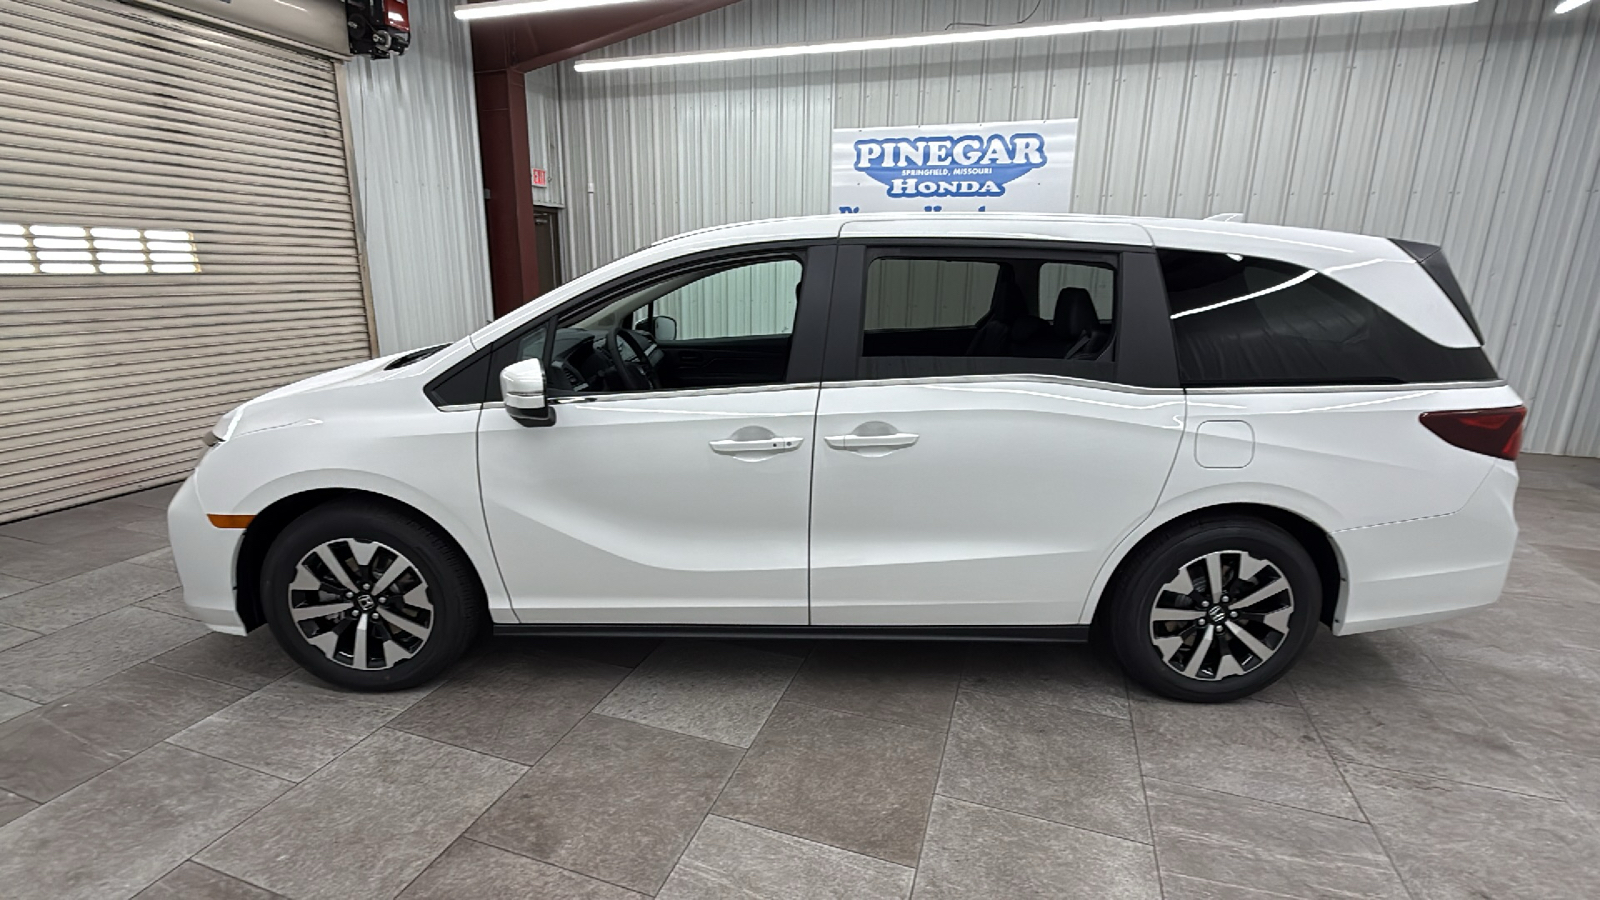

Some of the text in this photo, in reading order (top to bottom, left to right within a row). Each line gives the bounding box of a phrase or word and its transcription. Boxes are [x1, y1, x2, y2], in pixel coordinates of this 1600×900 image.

[857, 136, 1043, 169] PINEGAR
[901, 167, 993, 177] SPRINGFIELD, MISSOURI
[890, 178, 1002, 194] HONDA
